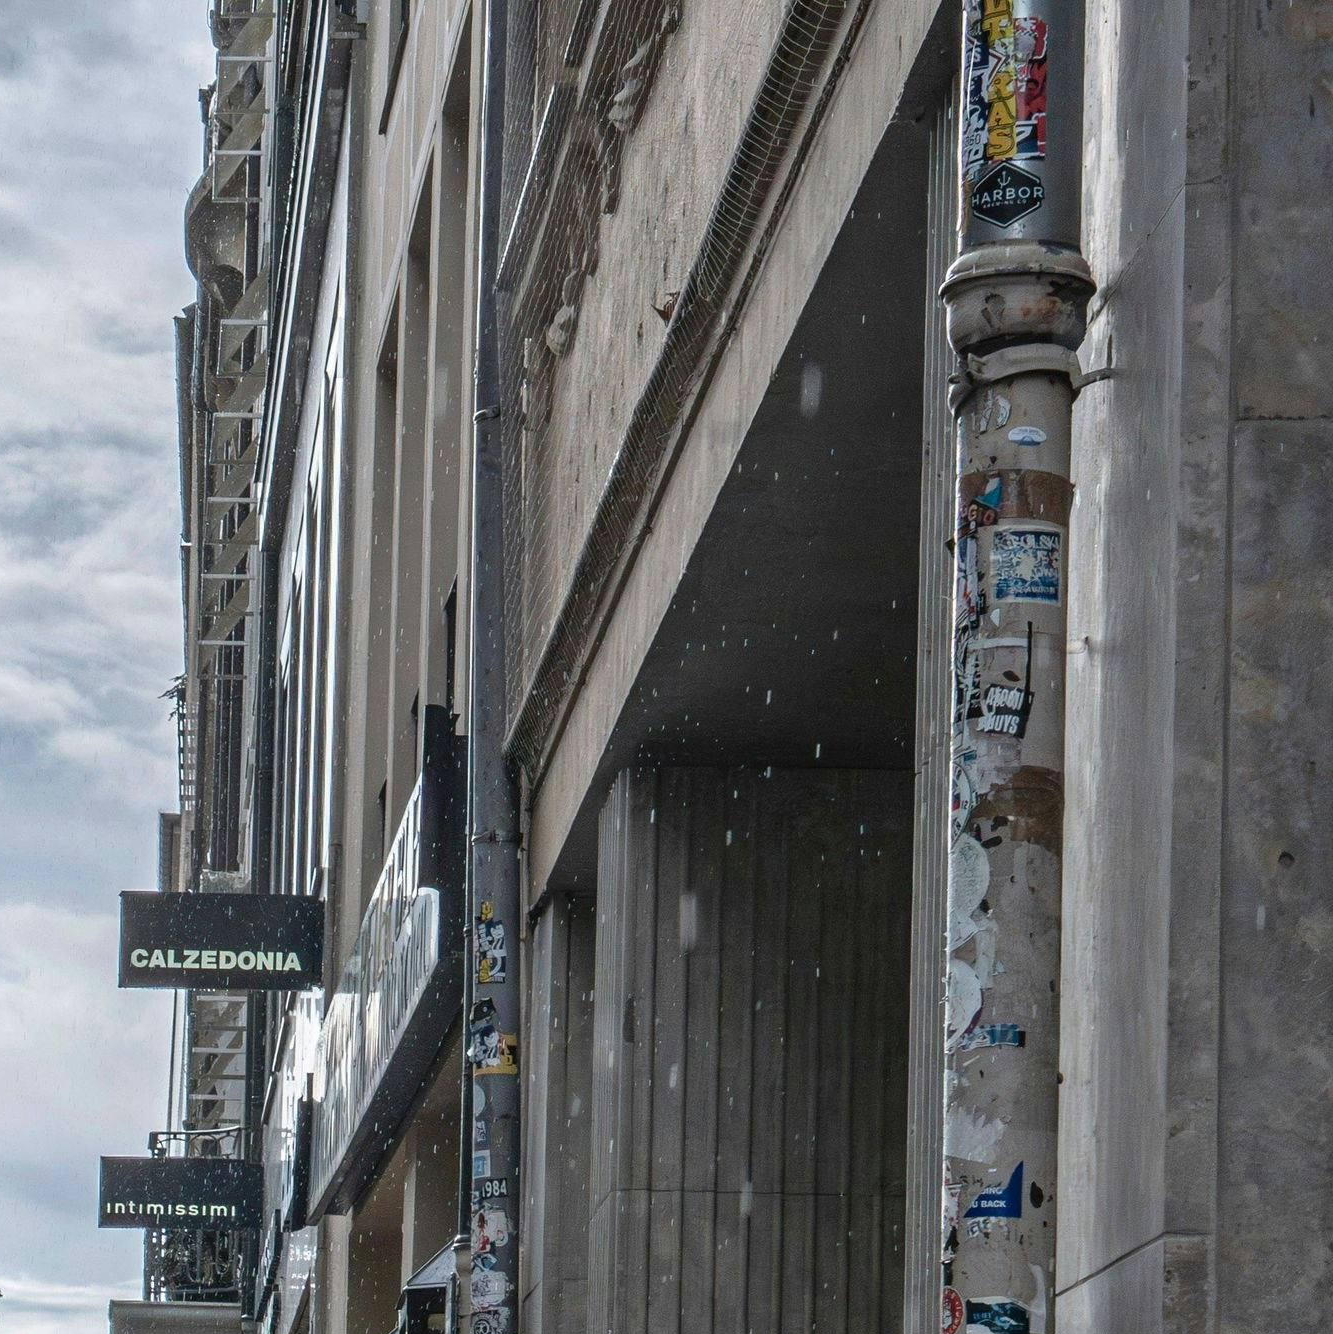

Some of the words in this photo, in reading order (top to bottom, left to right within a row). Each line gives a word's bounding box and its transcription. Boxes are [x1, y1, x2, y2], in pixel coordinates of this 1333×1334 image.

[971, 186, 1044, 207] HARBOR
[130, 948, 302, 972] CALZEDONIA
[482, 1179, 507, 1197] 1984
[106, 1200, 236, 1217] intimissimi
[981, 1200, 1007, 1208] BACK
